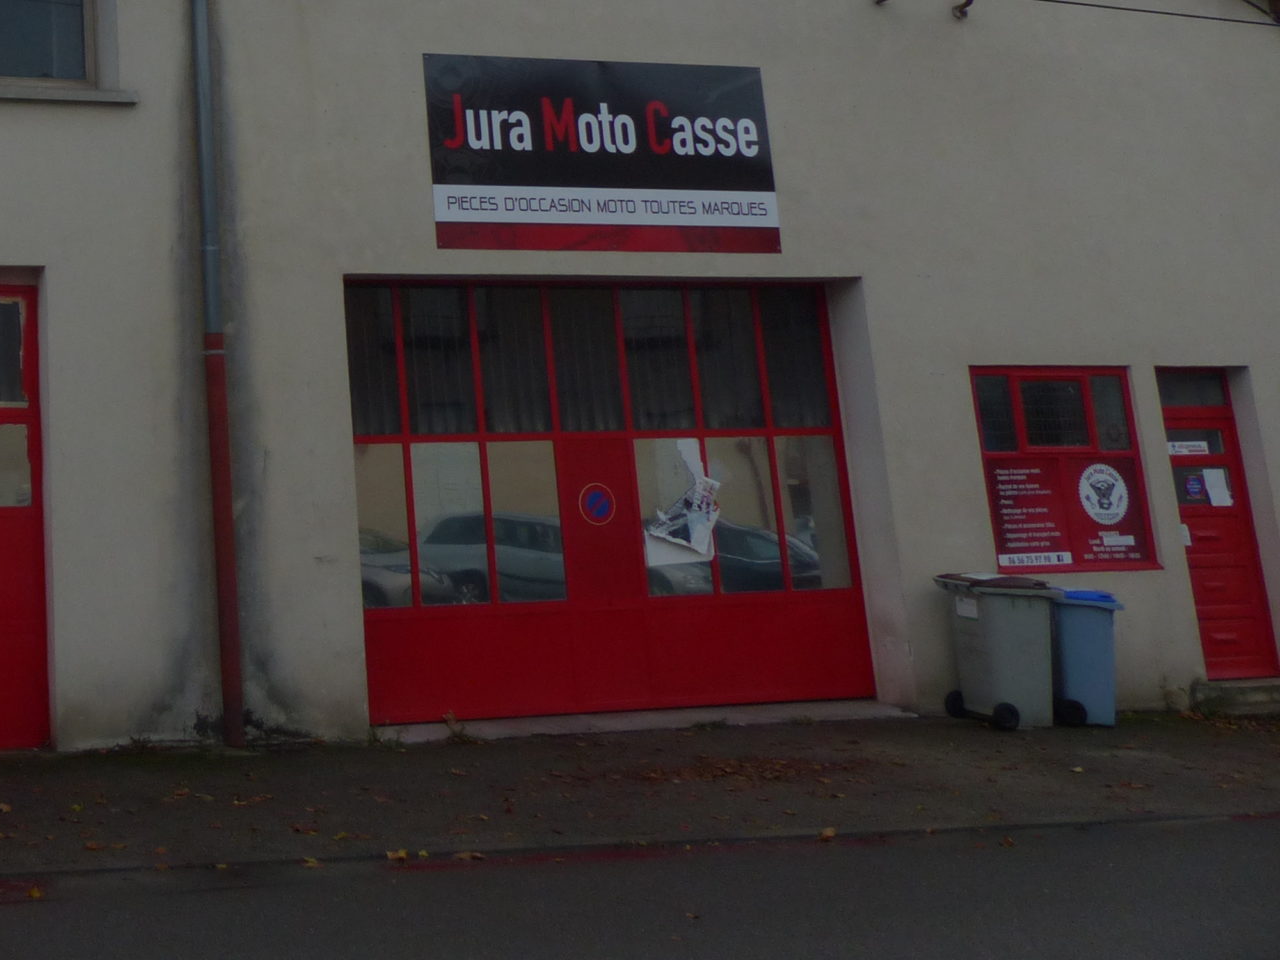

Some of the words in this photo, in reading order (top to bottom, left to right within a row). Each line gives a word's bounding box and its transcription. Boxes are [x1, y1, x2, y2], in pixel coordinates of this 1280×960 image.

[443, 93, 533, 151] Jura
[540, 97, 637, 154] Moto
[646, 100, 759, 157] Casse
[447, 195, 499, 211] PIECES
[504, 196, 592, 213] D'OCCASION
[596, 198, 636, 214] MOTO
[641, 199, 697, 215] TOUTES
[701, 200, 768, 217] MARQUES
